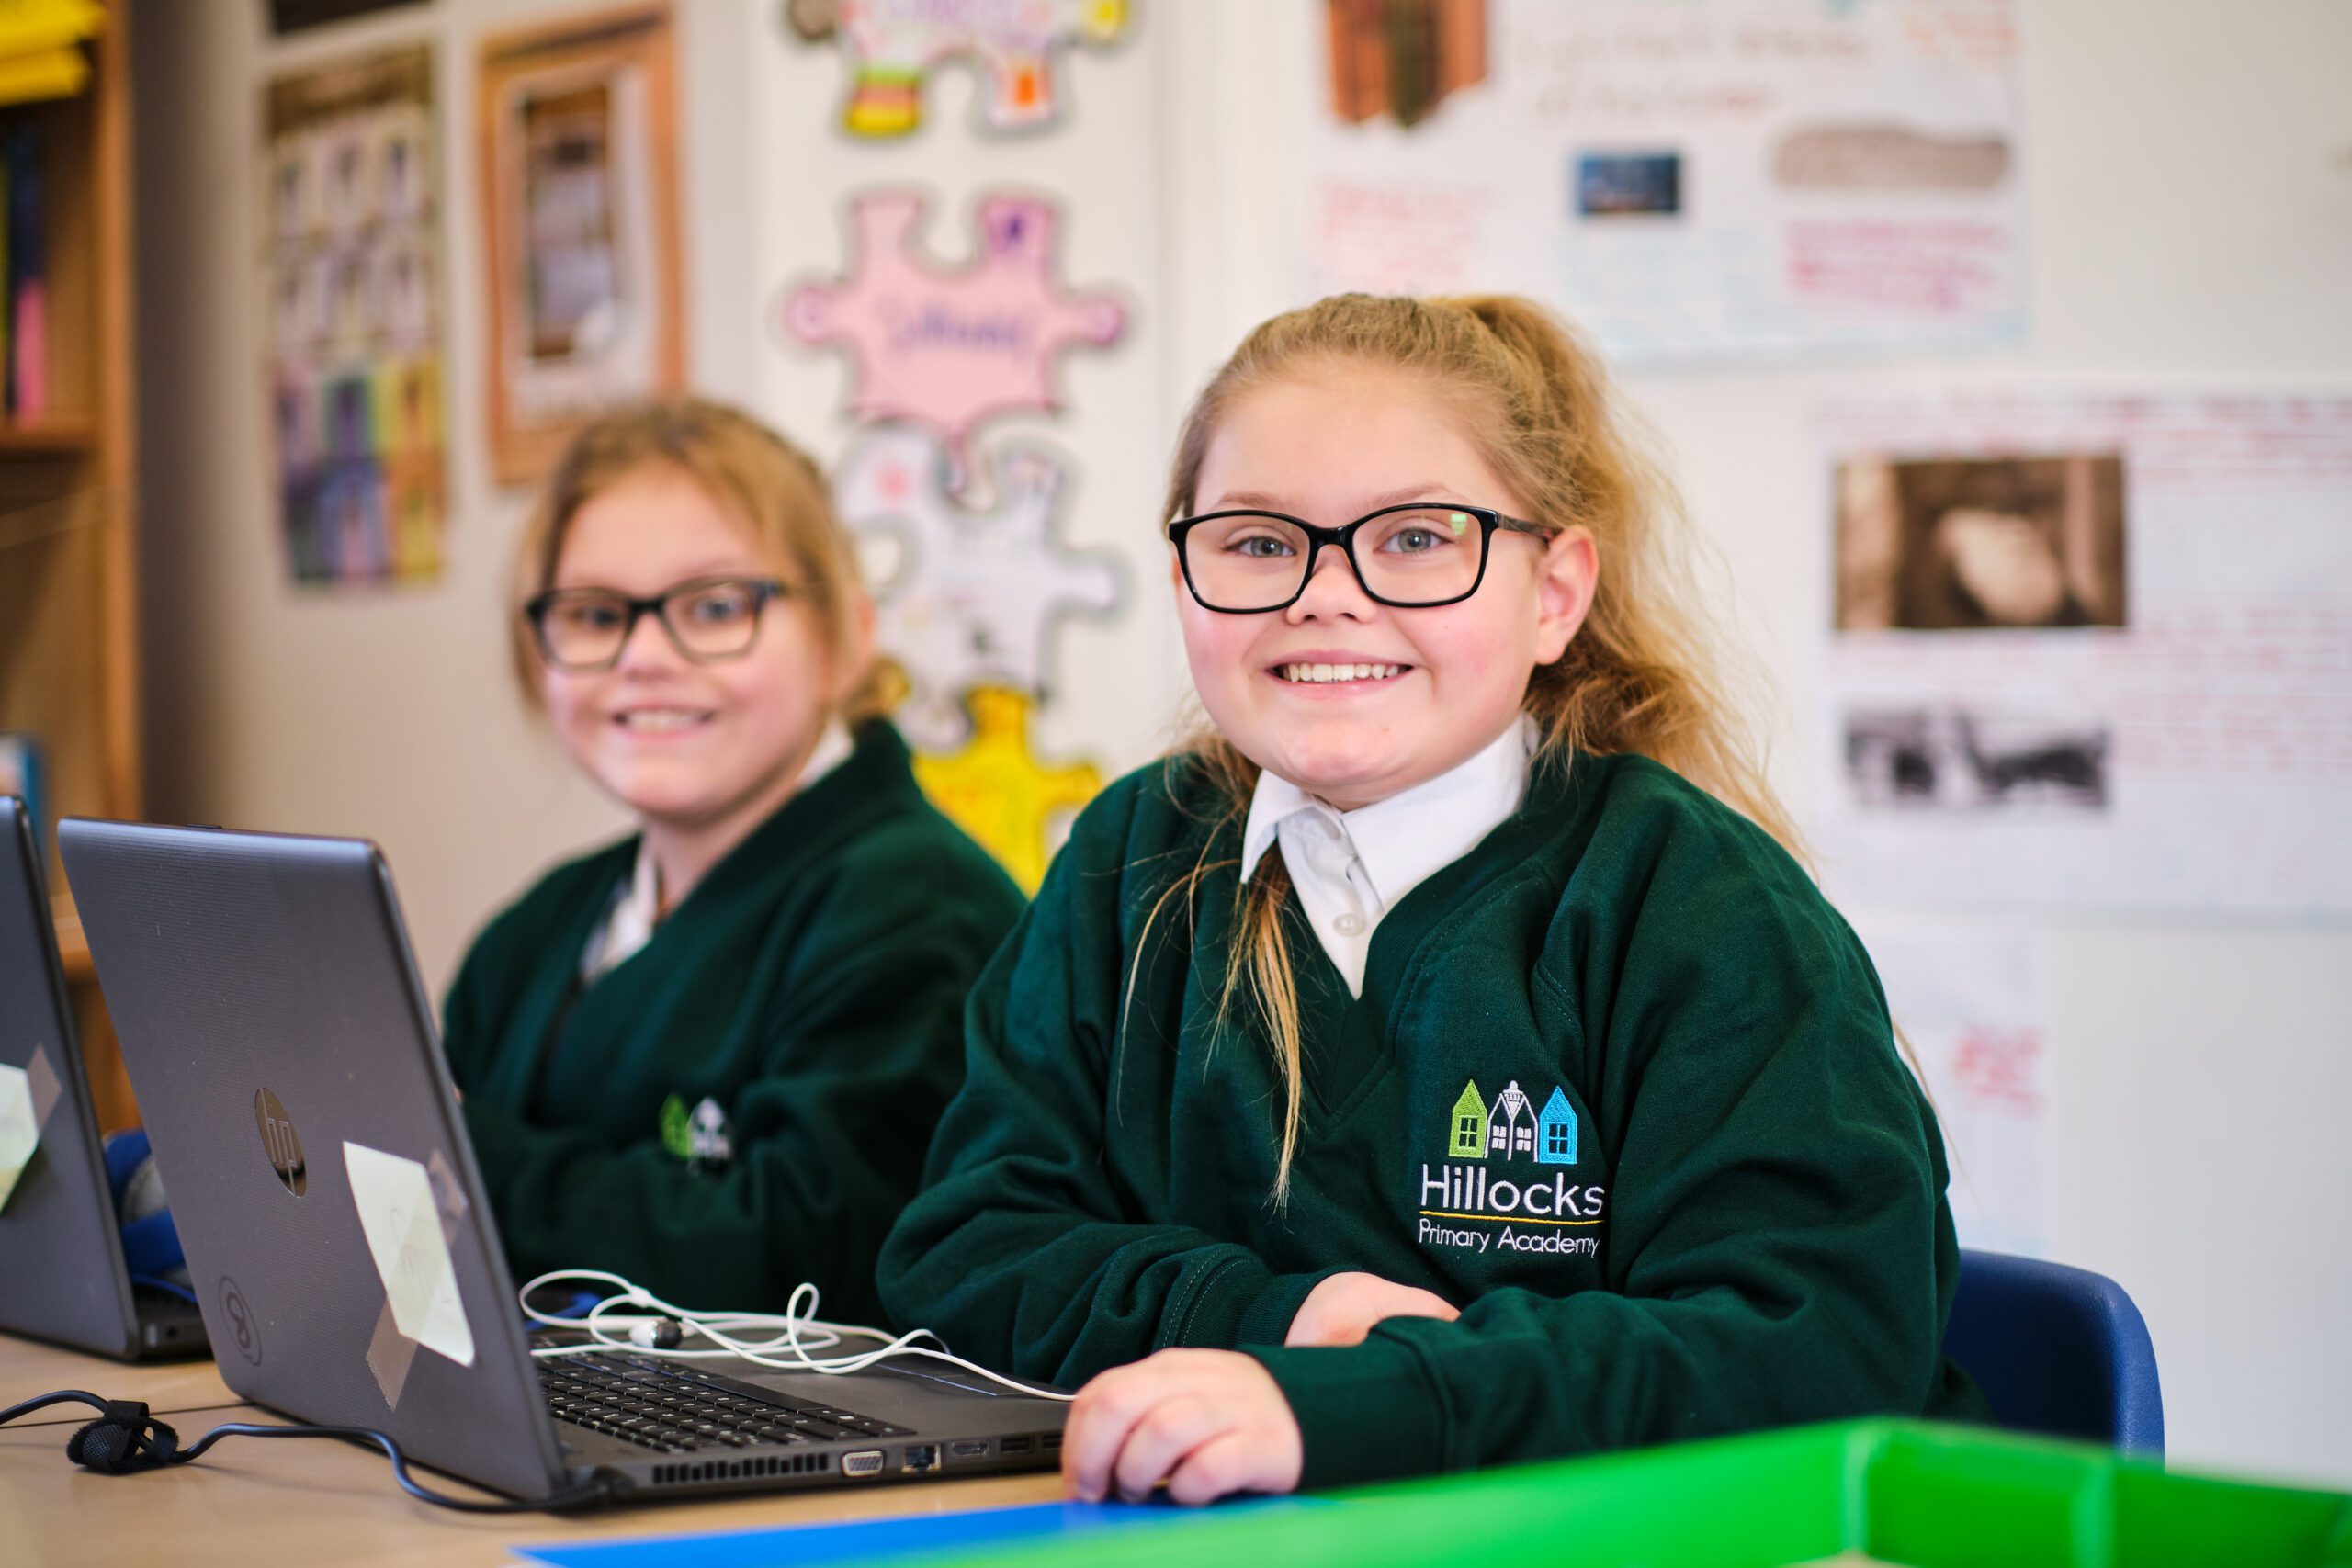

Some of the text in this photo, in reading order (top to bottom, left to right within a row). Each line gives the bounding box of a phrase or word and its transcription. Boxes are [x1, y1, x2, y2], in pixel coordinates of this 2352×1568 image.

[1420, 1163, 1605, 1217] Hillocks
[1419, 1218, 1600, 1258] Primary Academy
